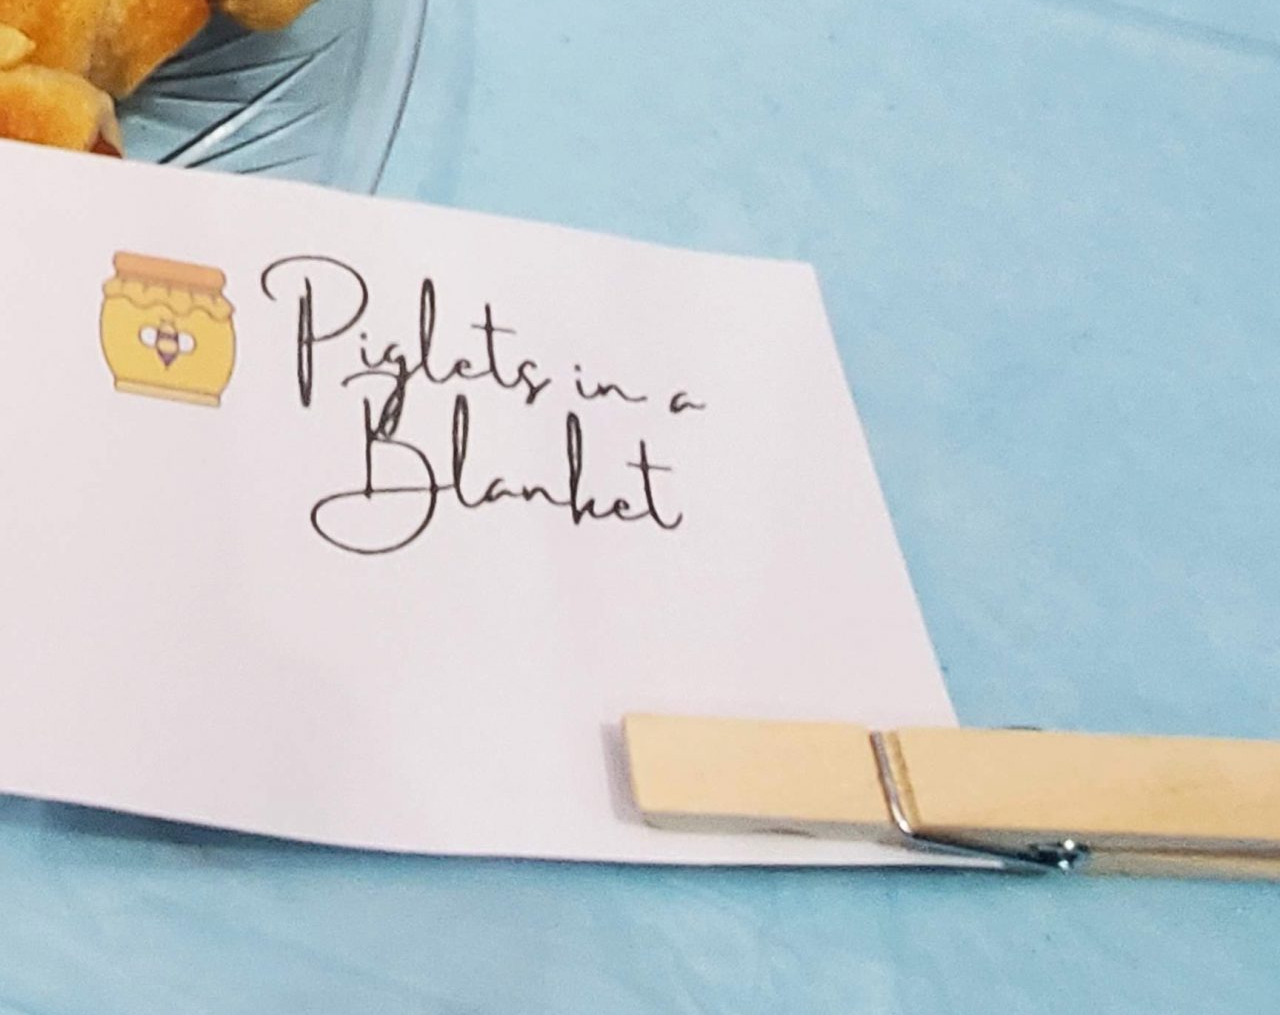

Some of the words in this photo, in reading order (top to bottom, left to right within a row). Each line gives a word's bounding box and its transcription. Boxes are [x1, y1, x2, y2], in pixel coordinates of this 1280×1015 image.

[261, 255, 552, 438] Piglets
[574, 364, 647, 402] in
[669, 392, 705, 414] a
[311, 371, 683, 555] Blanket
